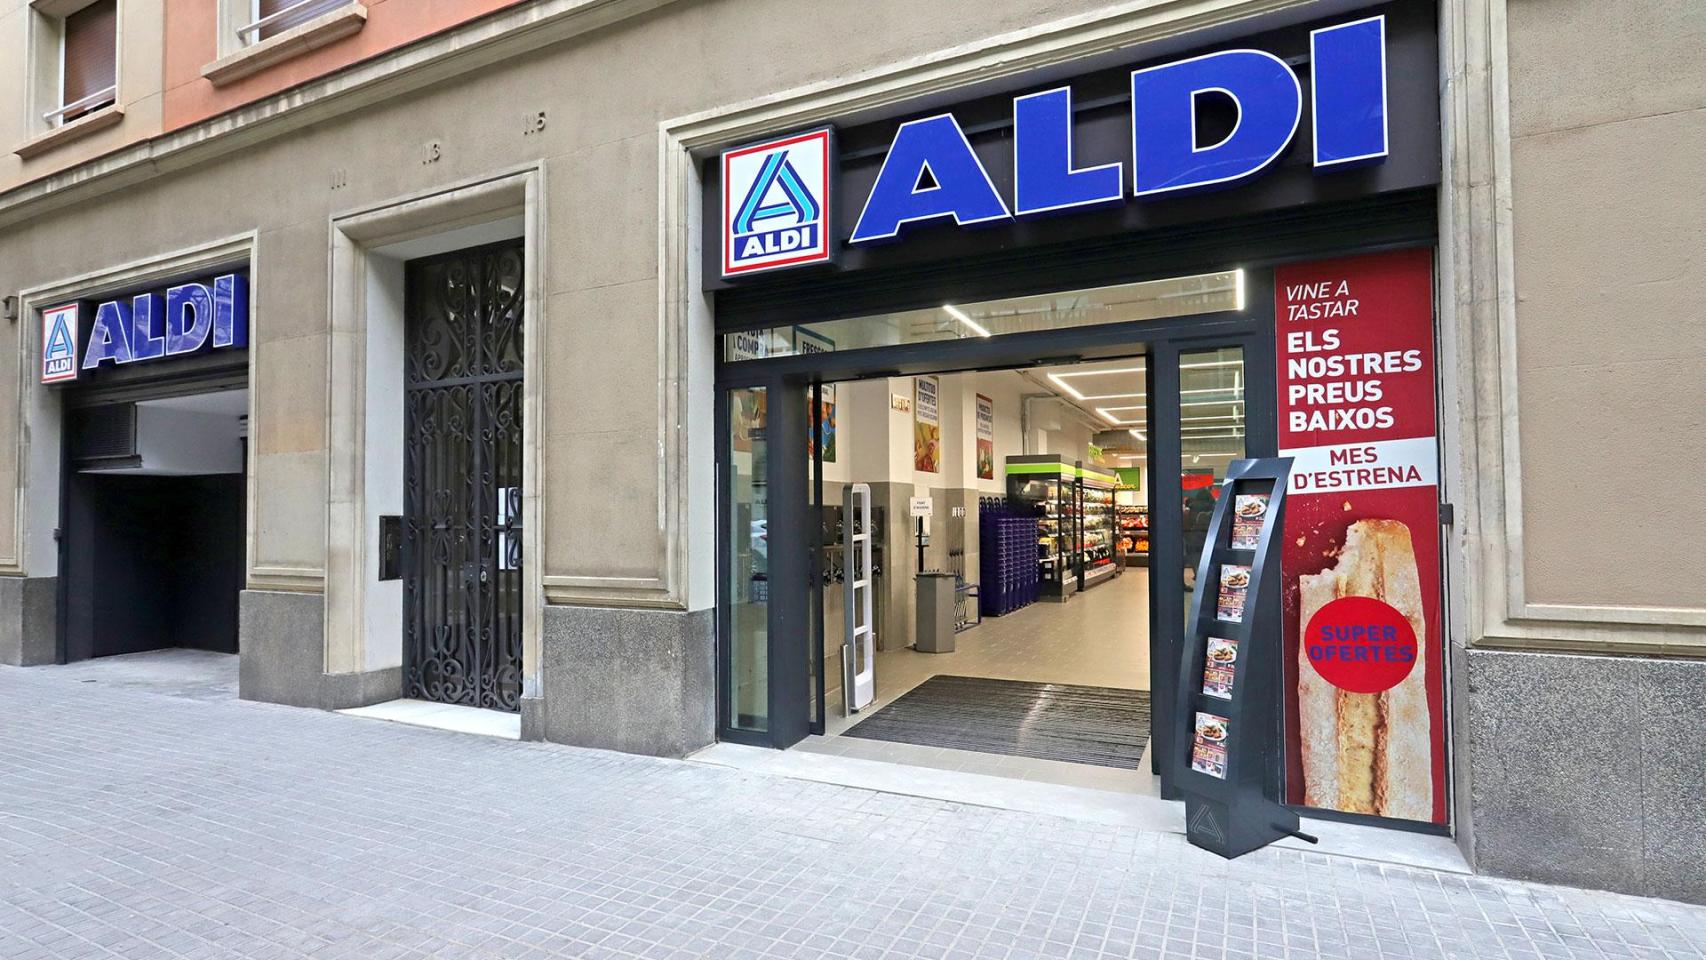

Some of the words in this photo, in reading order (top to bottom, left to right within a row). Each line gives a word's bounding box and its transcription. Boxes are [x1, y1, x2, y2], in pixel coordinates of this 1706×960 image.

[849, 15, 1389, 243] ALDI
[741, 226, 811, 258] ALDI
[1286, 281, 1333, 301] VINE
[1334, 280, 1350, 297] A
[82, 274, 236, 370] ALDI
[1287, 299, 1359, 321] TASTAR
[1287, 329, 1341, 353] ELS
[47, 359, 71, 375] ALDI
[1288, 350, 1423, 380] NOSTRES
[1288, 380, 1383, 406] PREUS
[1289, 407, 1395, 432] BAIXOS
[1329, 446, 1378, 466] MES
[1294, 464, 1422, 490] D'ESTRENA
[1320, 625, 1397, 642] SUPER
[1309, 645, 1413, 663] OFERTES
